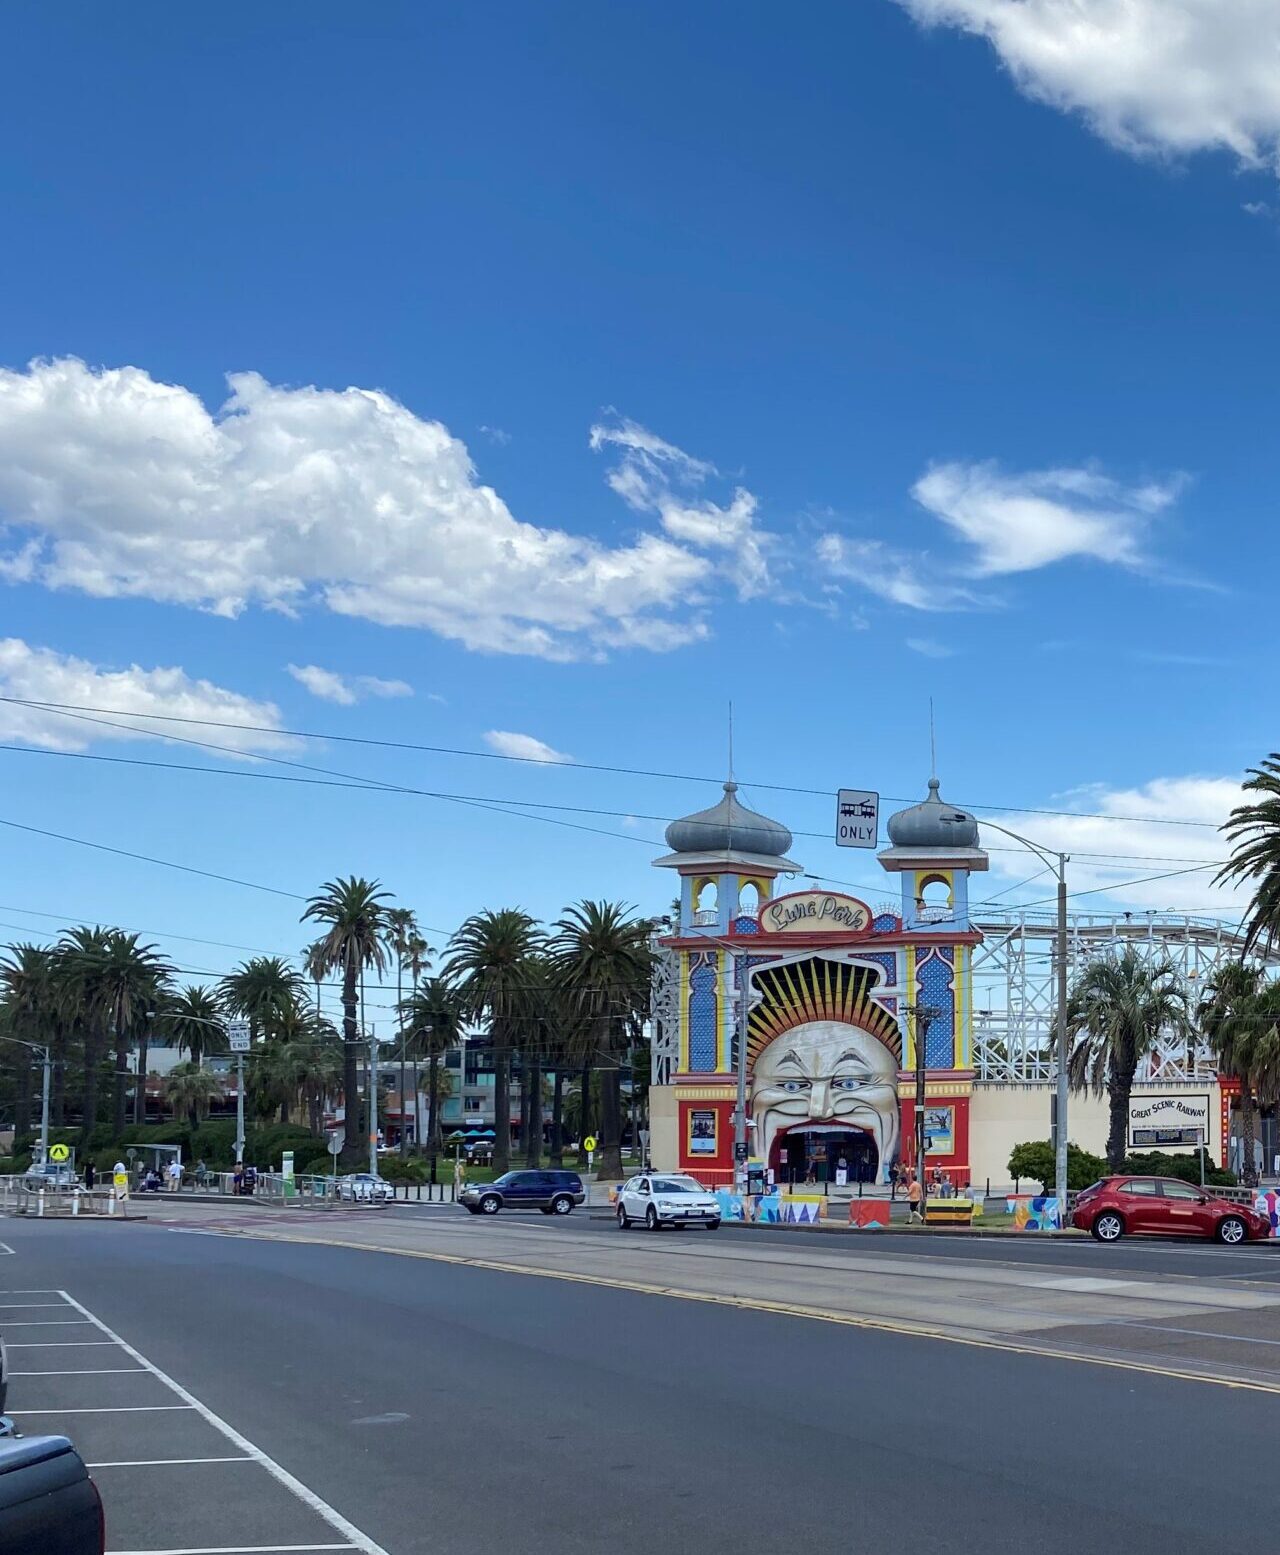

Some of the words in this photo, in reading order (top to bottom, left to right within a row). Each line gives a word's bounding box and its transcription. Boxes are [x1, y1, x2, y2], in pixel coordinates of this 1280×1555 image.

[840, 825, 874, 841] ONLY
[770, 901, 817, 931] Luna
[818, 896, 863, 930] Park
[230, 1031, 248, 1039] ONLY
[1131, 1108, 1152, 1119] GREAT
[1152, 1100, 1176, 1113] SCENIC
[1176, 1101, 1205, 1117] RAILWAY
